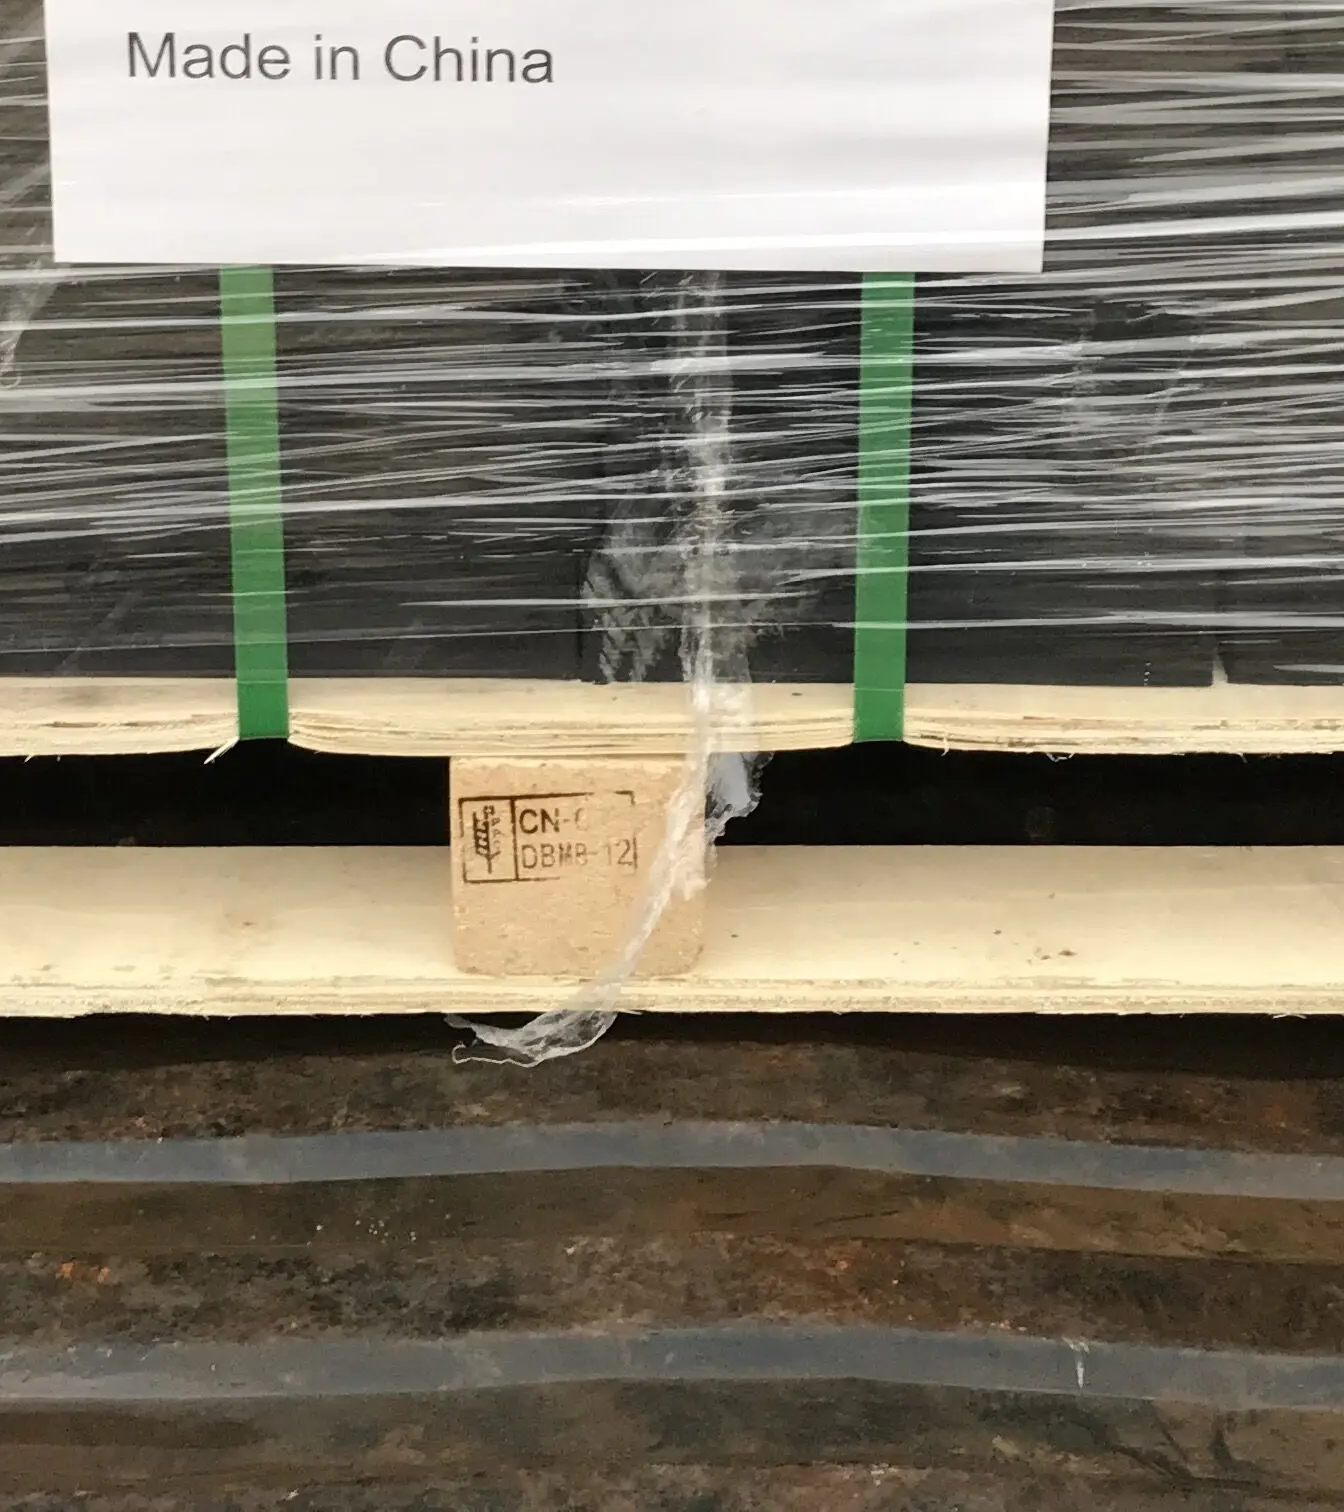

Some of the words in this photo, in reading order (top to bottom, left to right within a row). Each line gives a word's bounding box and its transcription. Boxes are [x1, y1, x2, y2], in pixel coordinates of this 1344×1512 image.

[128, 32, 290, 80] Made
[315, 44, 360, 80] in
[384, 34, 553, 83] China
